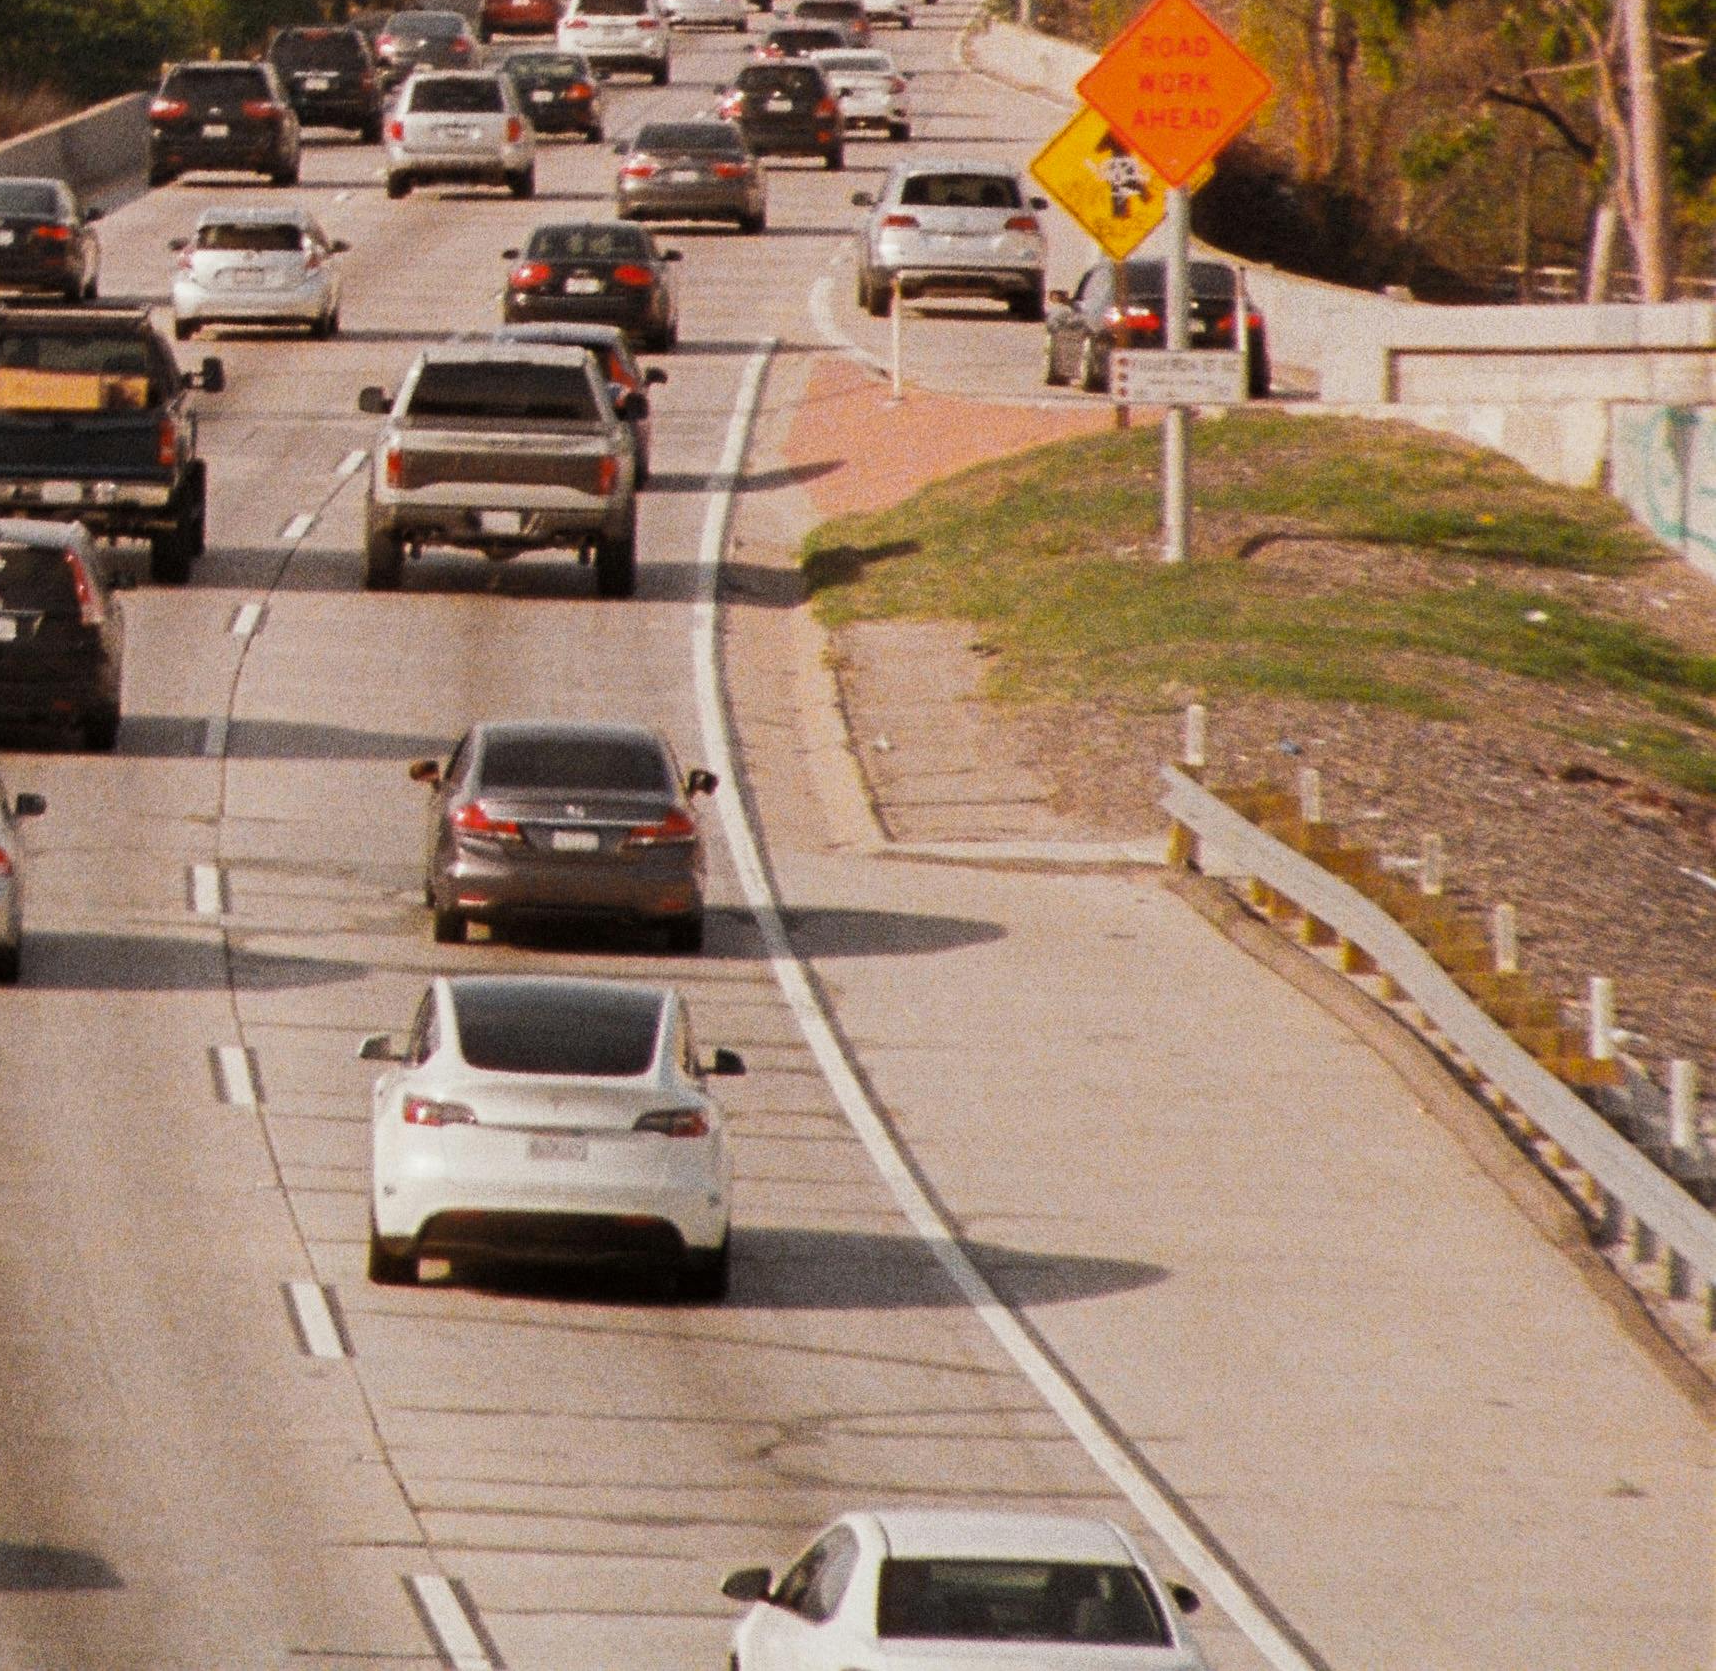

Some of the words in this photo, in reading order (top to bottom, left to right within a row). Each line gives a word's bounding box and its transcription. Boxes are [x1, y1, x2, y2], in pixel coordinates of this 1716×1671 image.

[1140, 36, 1211, 58] ROAD
[1138, 73, 1211, 94] WORK
[1132, 107, 1222, 129] AHEAD
